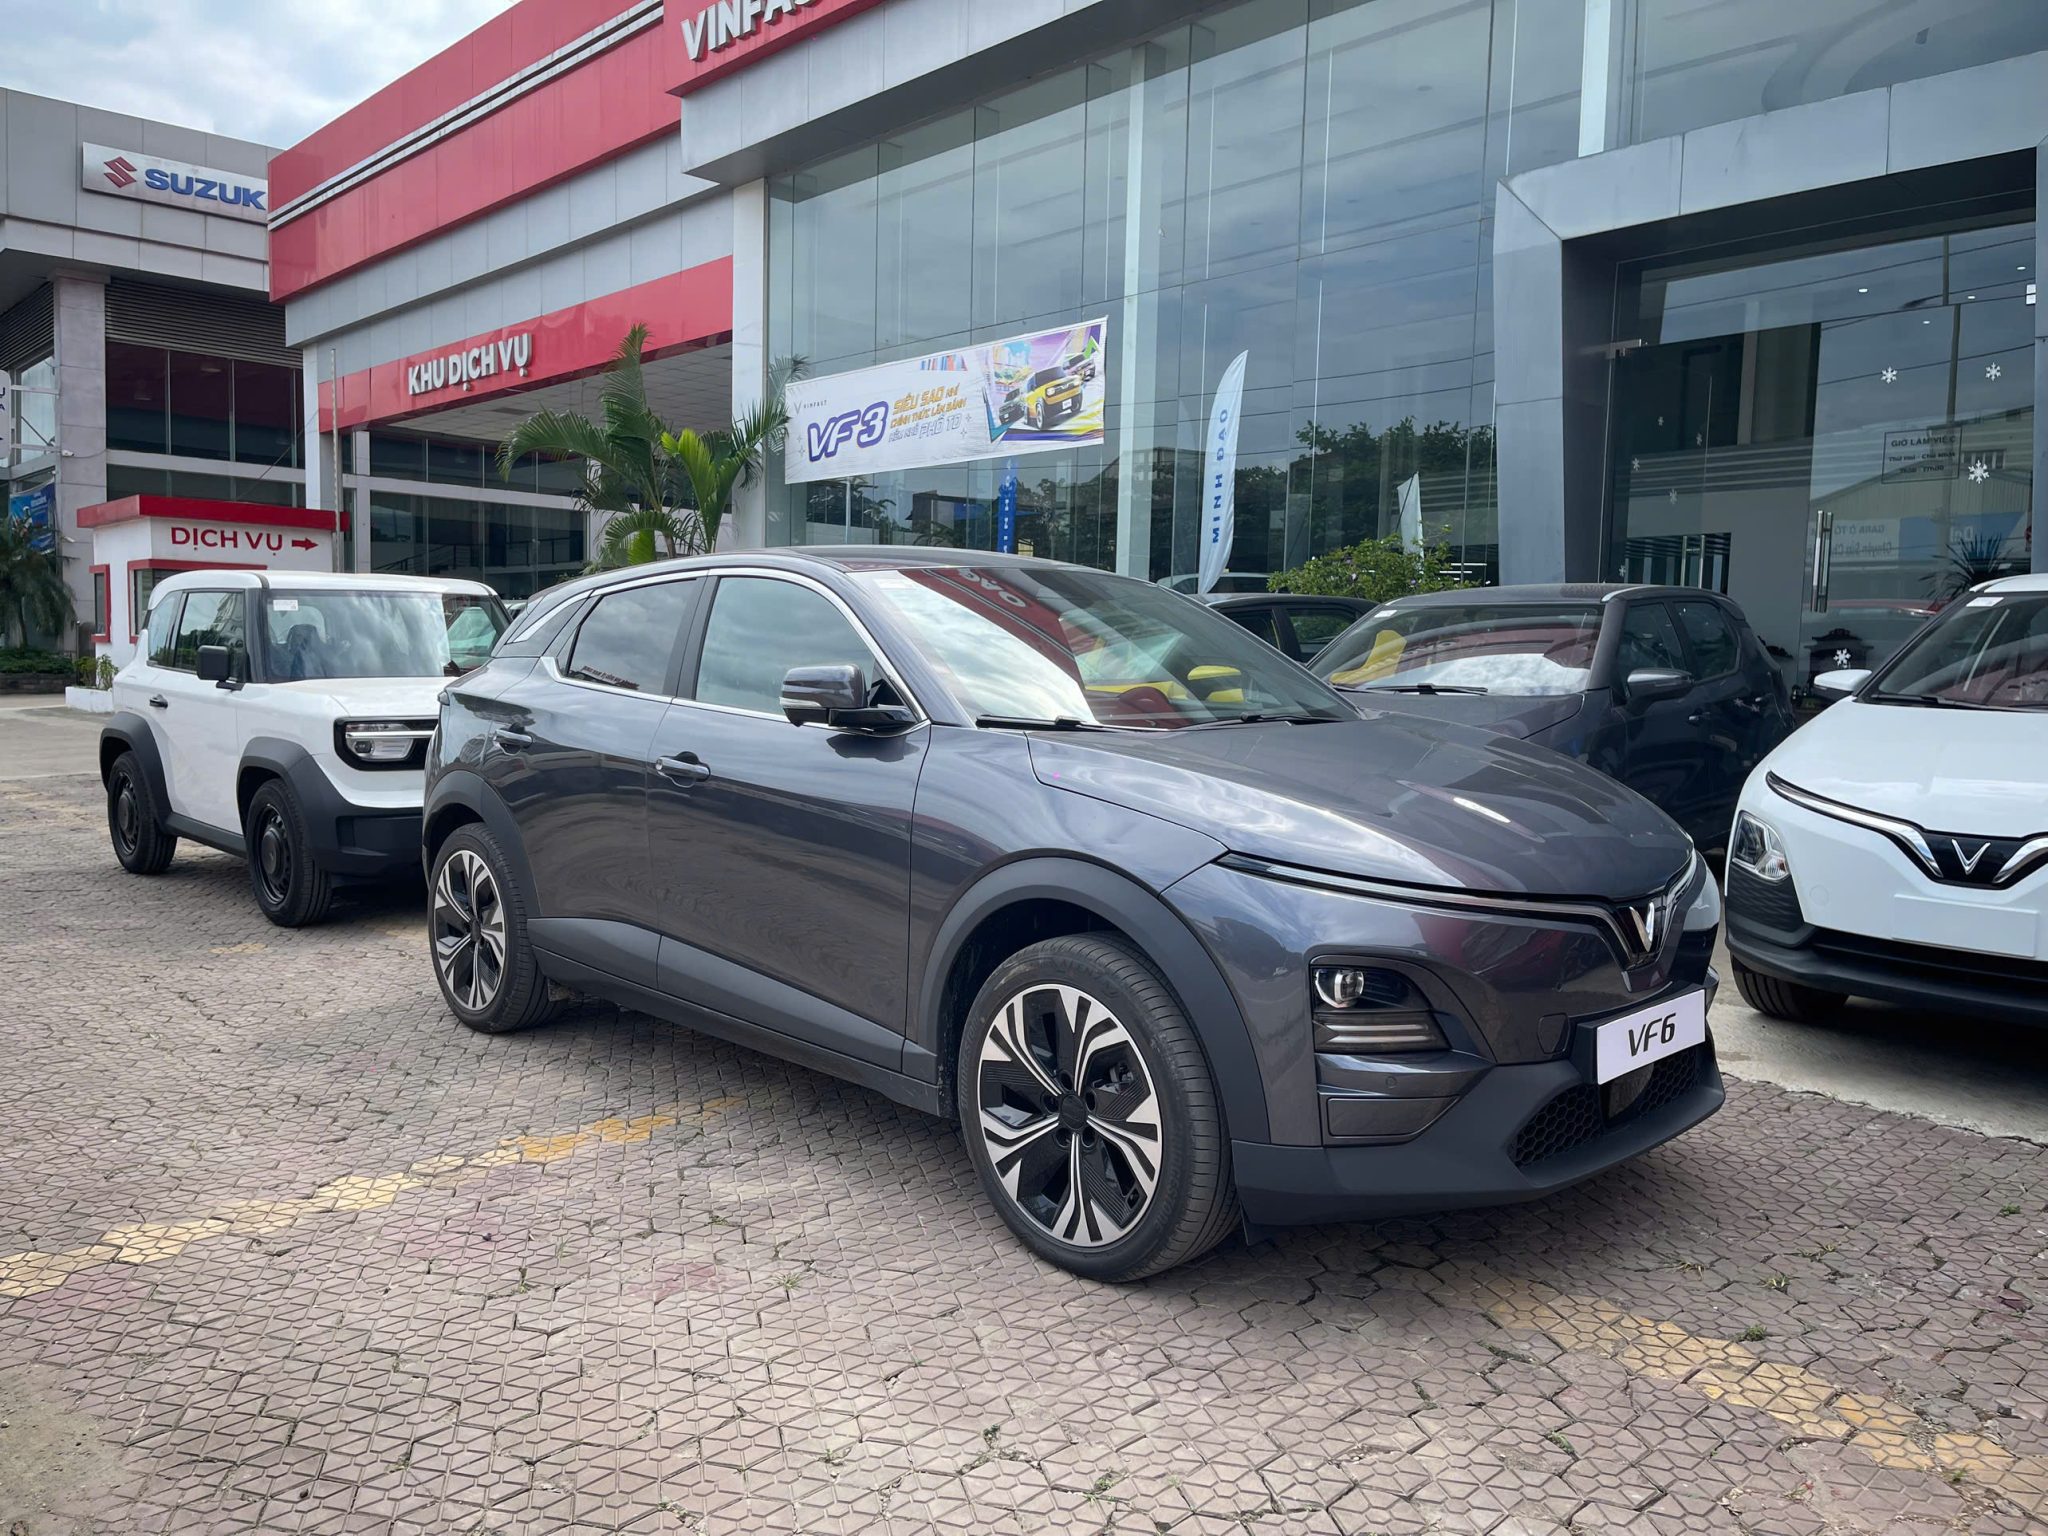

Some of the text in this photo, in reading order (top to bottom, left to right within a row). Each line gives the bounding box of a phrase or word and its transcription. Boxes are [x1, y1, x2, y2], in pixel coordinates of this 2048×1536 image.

[408, 333, 532, 395] KHU DỊCH VỤ
[1212, 474, 1223, 544] MINH
[170, 526, 283, 556] DỊCH VỤ
[1628, 1012, 1677, 1057] VF6
